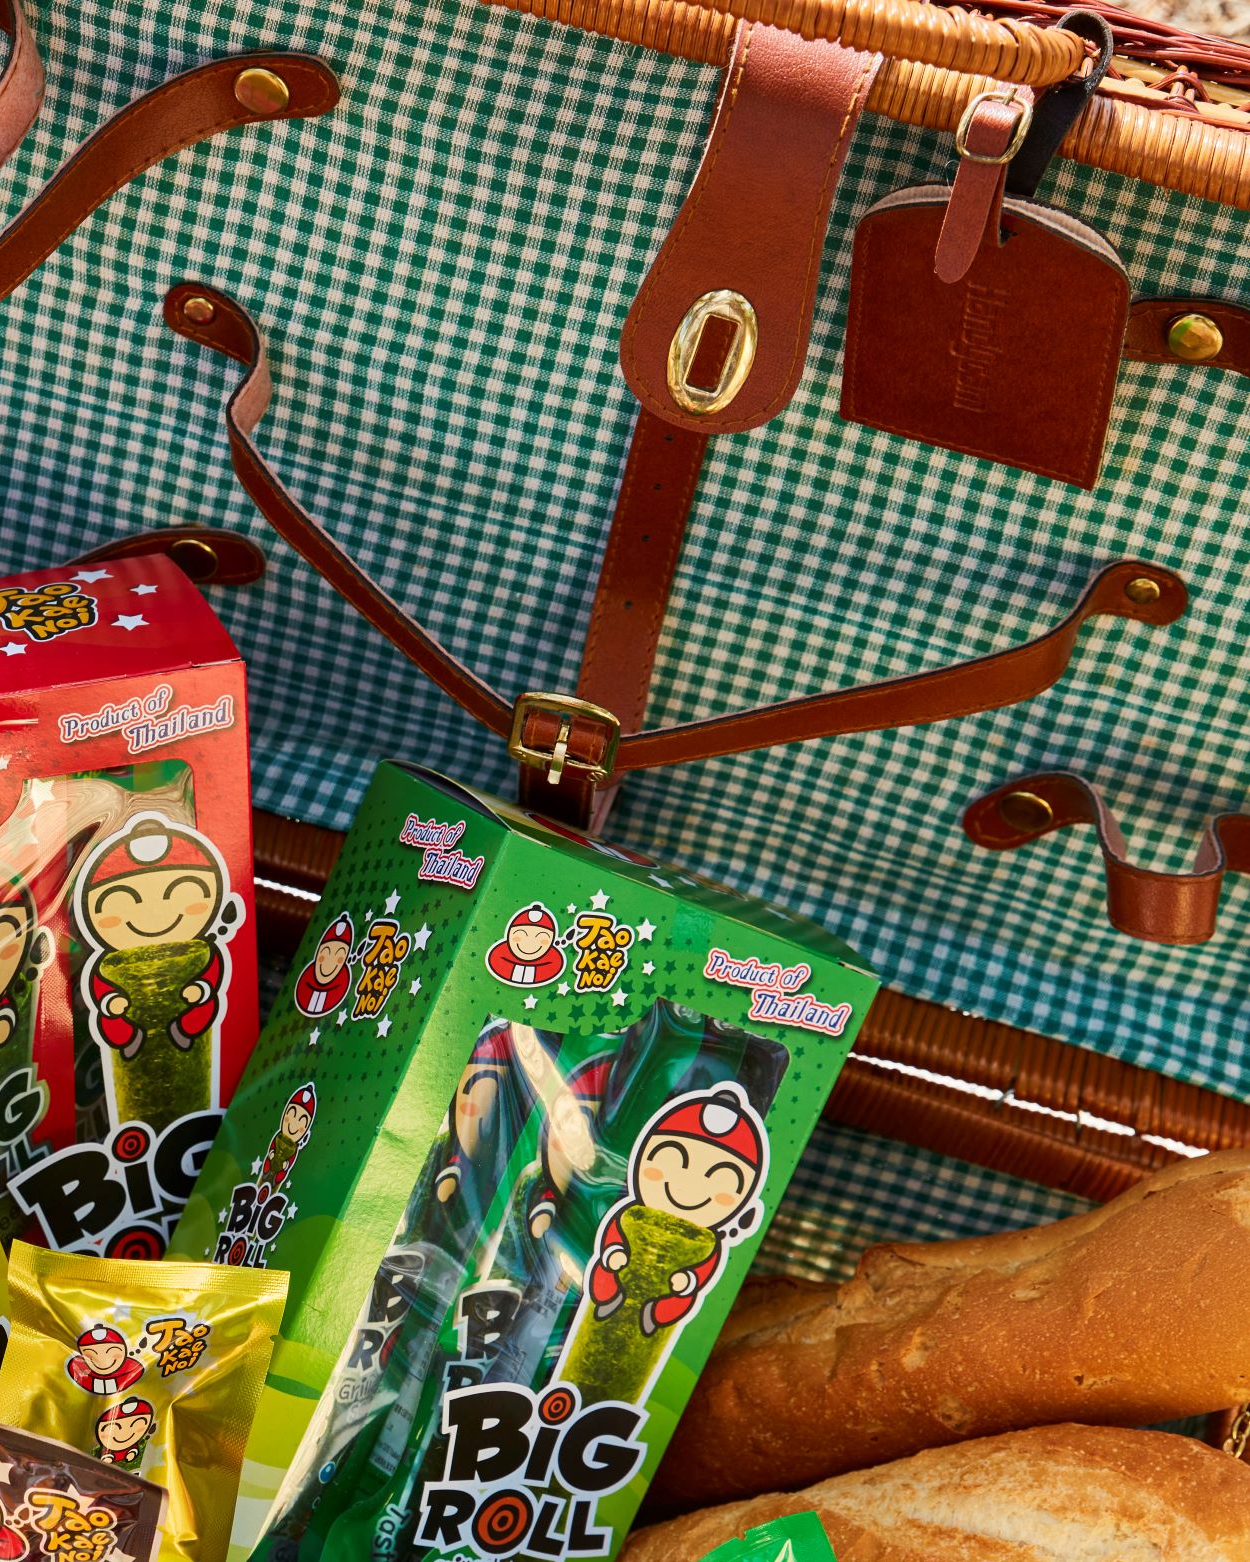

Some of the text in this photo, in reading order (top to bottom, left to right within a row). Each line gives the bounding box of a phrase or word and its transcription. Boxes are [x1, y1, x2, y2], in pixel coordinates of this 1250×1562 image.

[11, 594, 89, 629] Kae
[36, 607, 95, 640] Noi
[65, 686, 170, 738] Product of
[130, 698, 228, 748] Thailand
[403, 820, 463, 845] Product of
[422, 851, 478, 884] Thailand
[365, 923, 408, 965] Tao
[577, 917, 631, 948] Tao
[579, 950, 623, 970] Kae
[708, 955, 805, 988] Product of
[359, 965, 397, 991] Kae
[579, 970, 615, 989] Noi
[355, 990, 387, 1014] Noi
[754, 992, 844, 1029] Thailand
[213, 1235, 266, 1268] ROLL
[147, 1319, 209, 1352] Tao
[160, 1339, 207, 1368] Kae
[165, 1353, 199, 1376] Noi
[30, 1490, 114, 1532] Tao
[420, 1487, 606, 1556] ROLL
[49, 1530, 112, 1555] Kae
